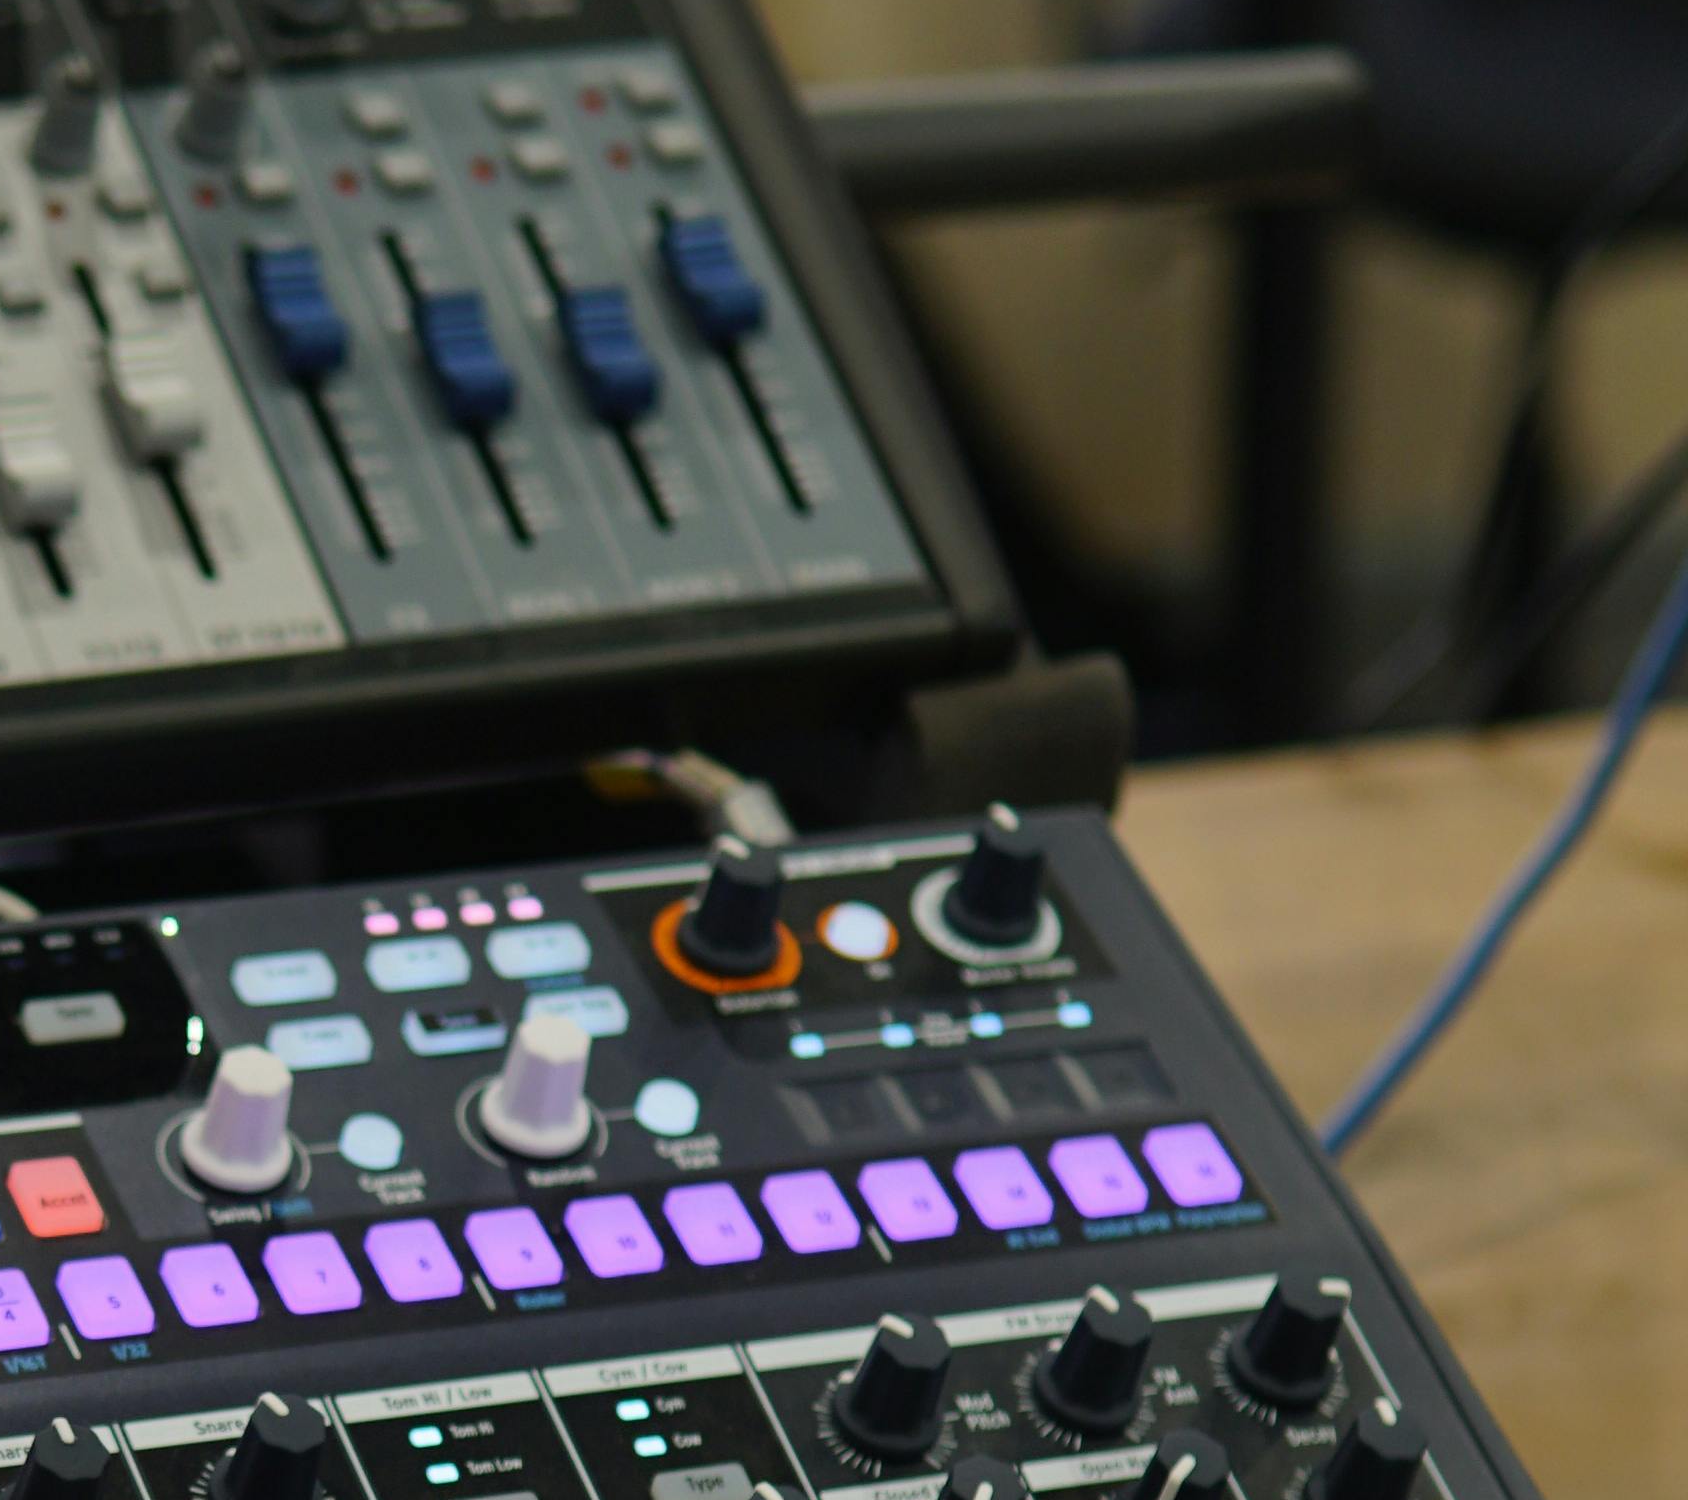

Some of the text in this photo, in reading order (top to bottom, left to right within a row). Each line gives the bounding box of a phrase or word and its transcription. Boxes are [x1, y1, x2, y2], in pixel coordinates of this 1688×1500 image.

[4, 1309, 16, 1323] 4
[194, 1416, 243, 1435] Snare
[685, 1475, 723, 1493] Type
